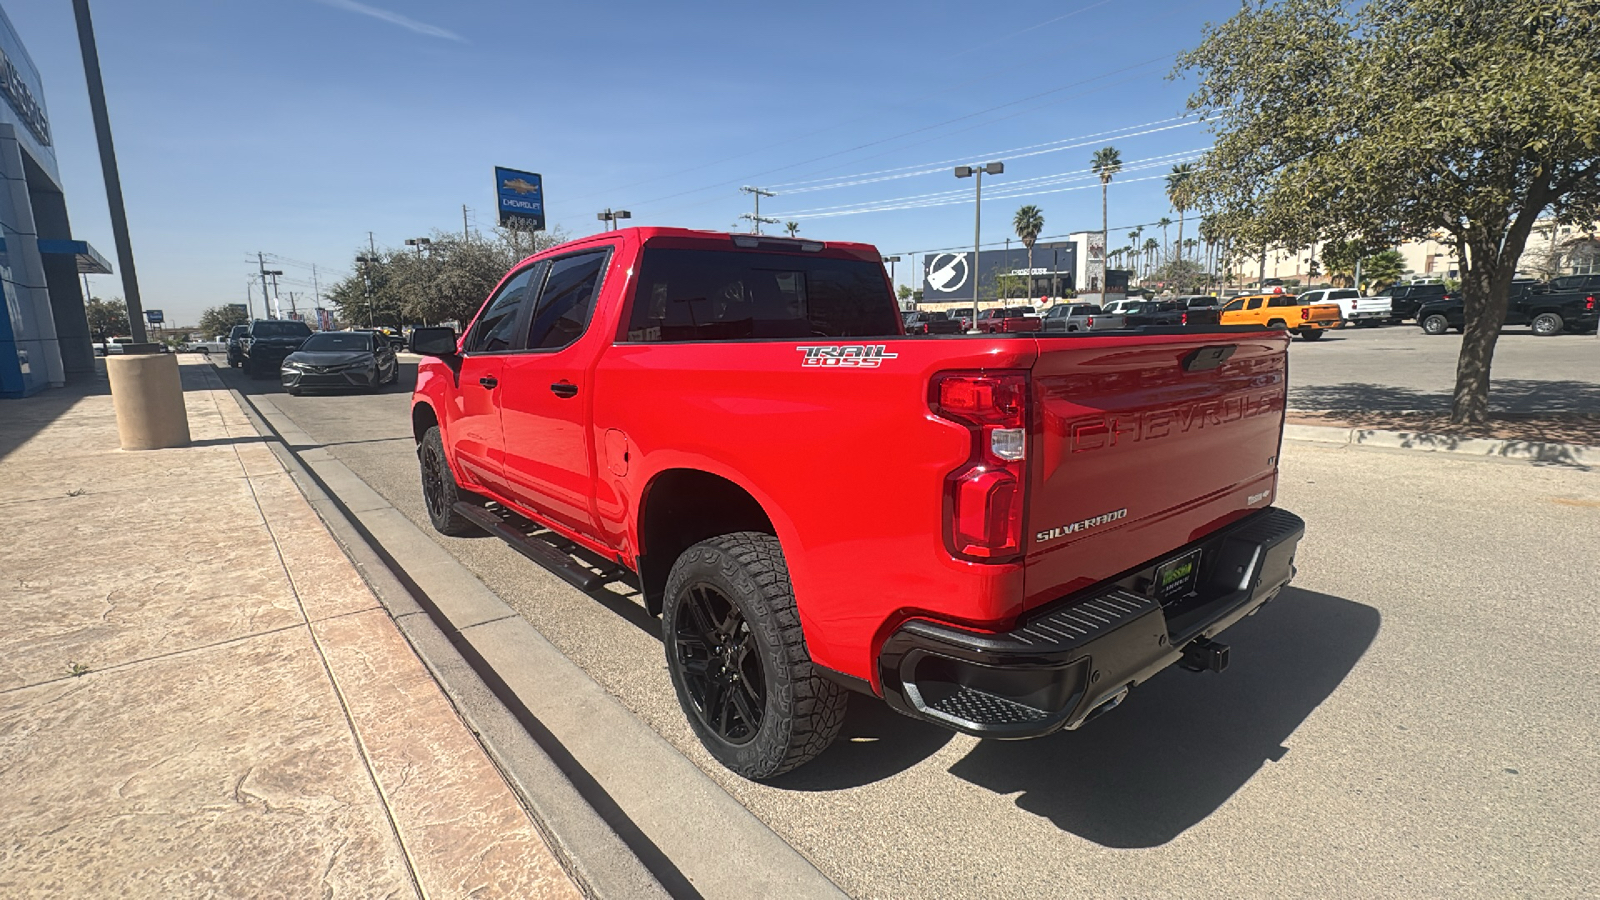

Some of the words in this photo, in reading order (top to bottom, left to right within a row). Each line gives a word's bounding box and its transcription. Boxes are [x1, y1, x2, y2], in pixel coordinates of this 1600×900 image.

[502, 198, 540, 210] CHEVROLET
[796, 345, 898, 359] TRAIL
[801, 357, 882, 368] BOSS
[1070, 388, 1284, 453] CHEVROLET
[1036, 508, 1128, 543] SILVERADO
